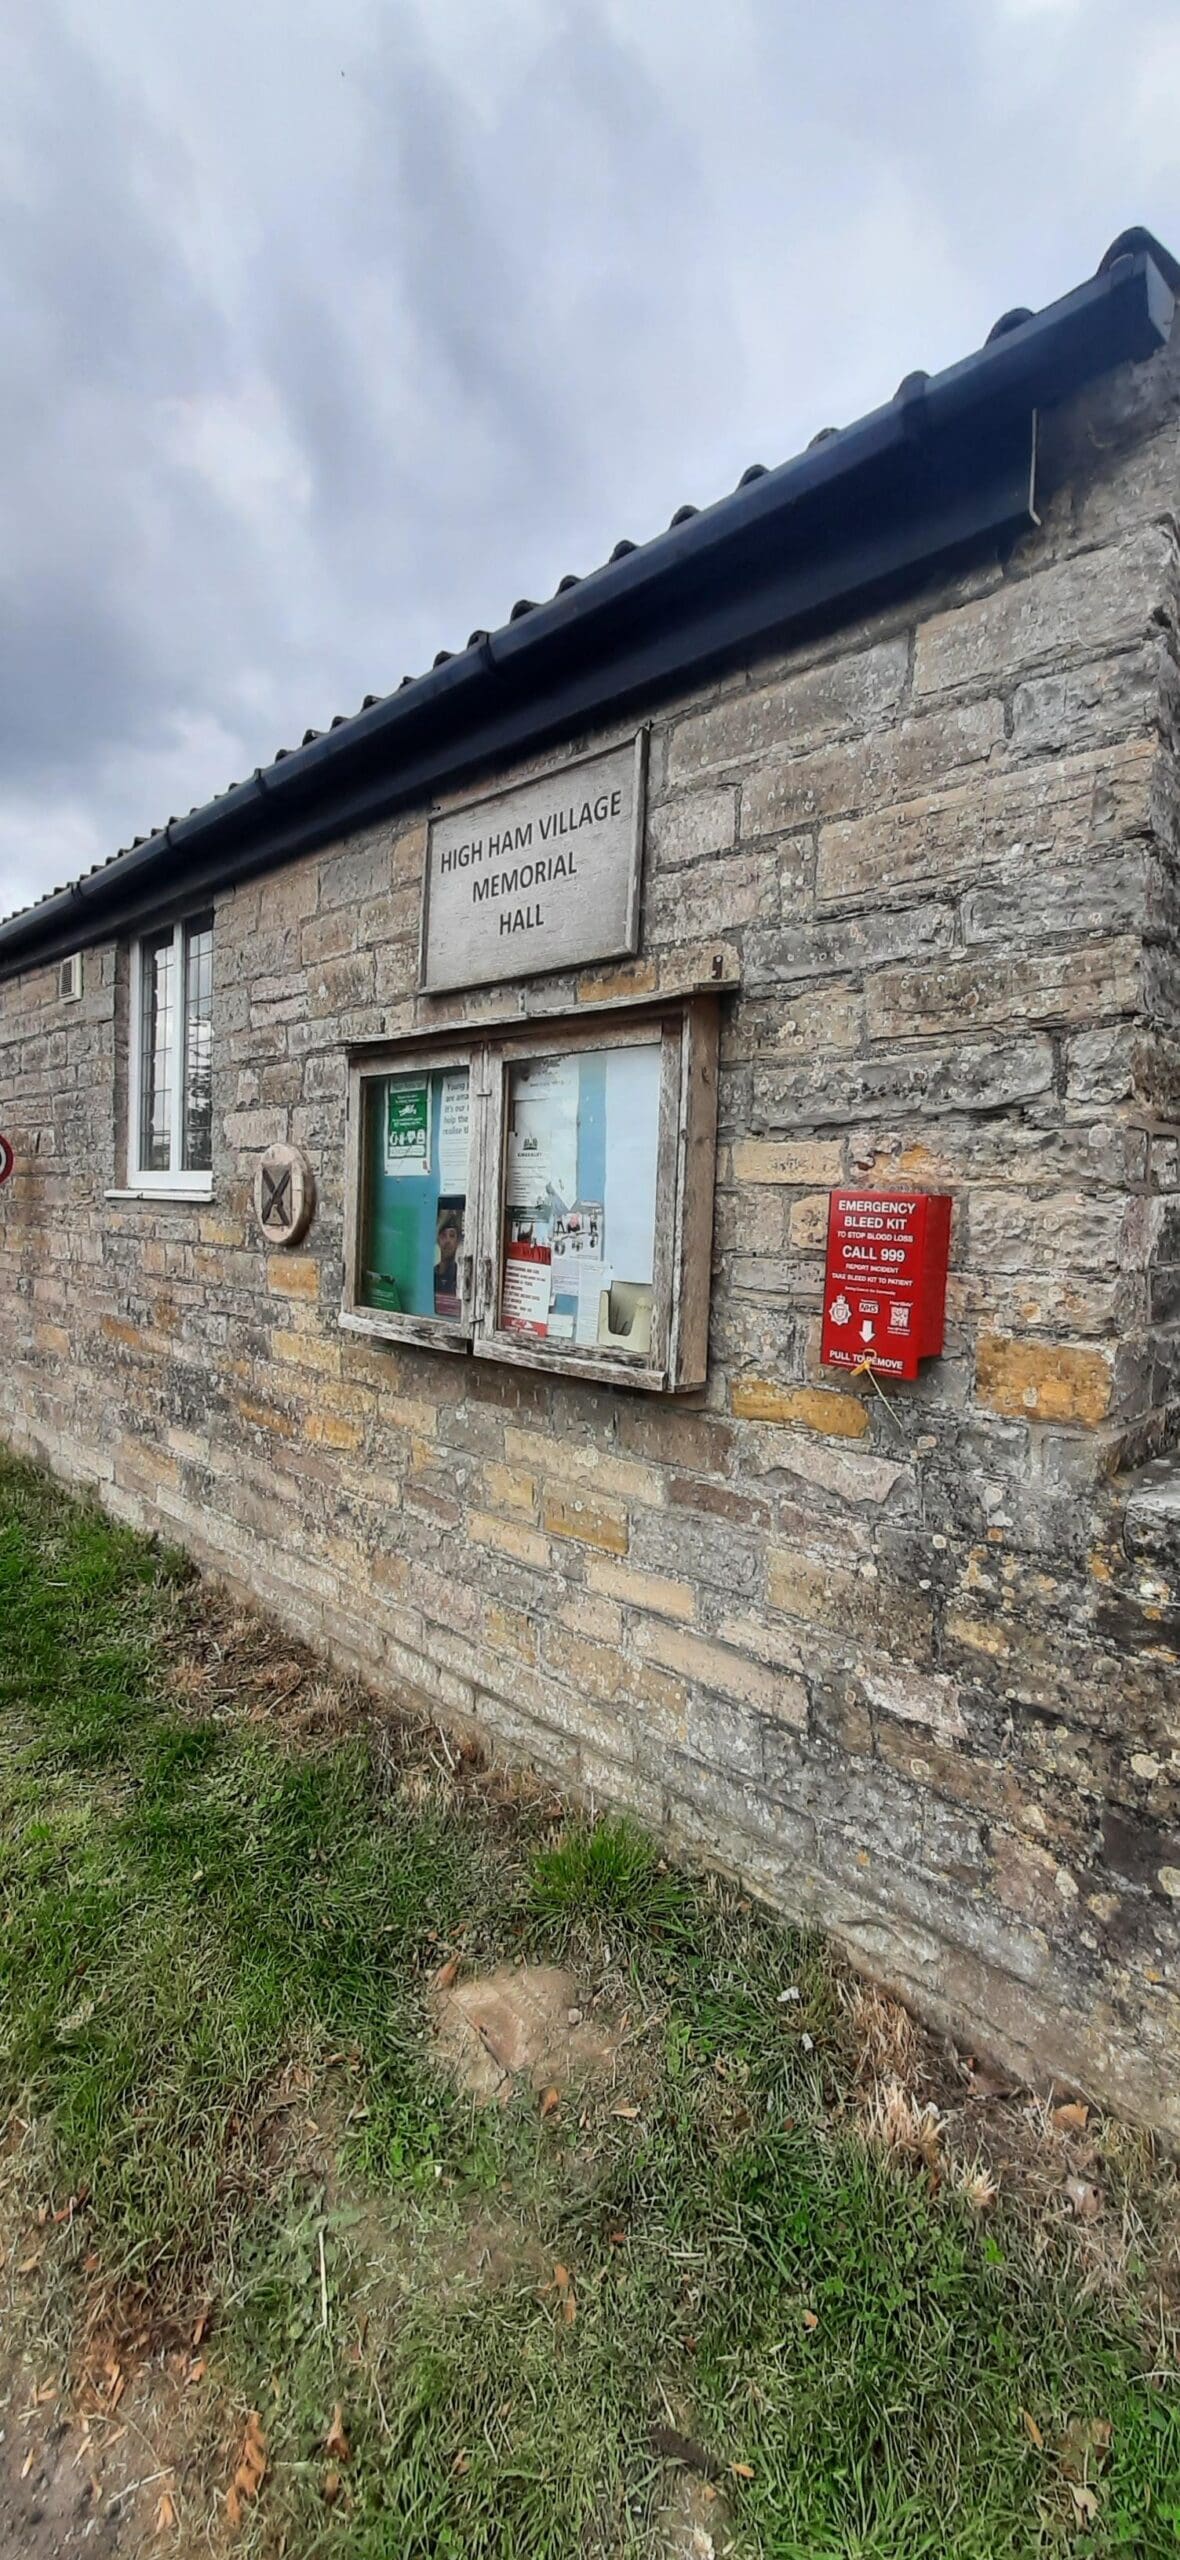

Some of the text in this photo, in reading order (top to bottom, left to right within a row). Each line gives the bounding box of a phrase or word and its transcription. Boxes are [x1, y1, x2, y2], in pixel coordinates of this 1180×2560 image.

[440, 790, 622, 874] HIGH HAM VILLAGE
[473, 851, 577, 903] MEMORIAL
[499, 903, 544, 935] HALL
[838, 1199, 916, 1214] EMERGENCY
[844, 1216, 908, 1230] BLEED KIT
[837, 1230, 914, 1243] TO STOP BLOOD LOSS
[842, 1245, 906, 1262] CALL 999
[845, 1263, 899, 1274] REPORT INCIDENT
[831, 1272, 846, 1280] TAKE
[847, 1274, 867, 1282] BLEED
[887, 1278, 913, 1287] PATIENT
[860, 1304, 877, 1312] NHS
[829, 1349, 851, 1361] PULL
[852, 1353, 865, 1363] TO
